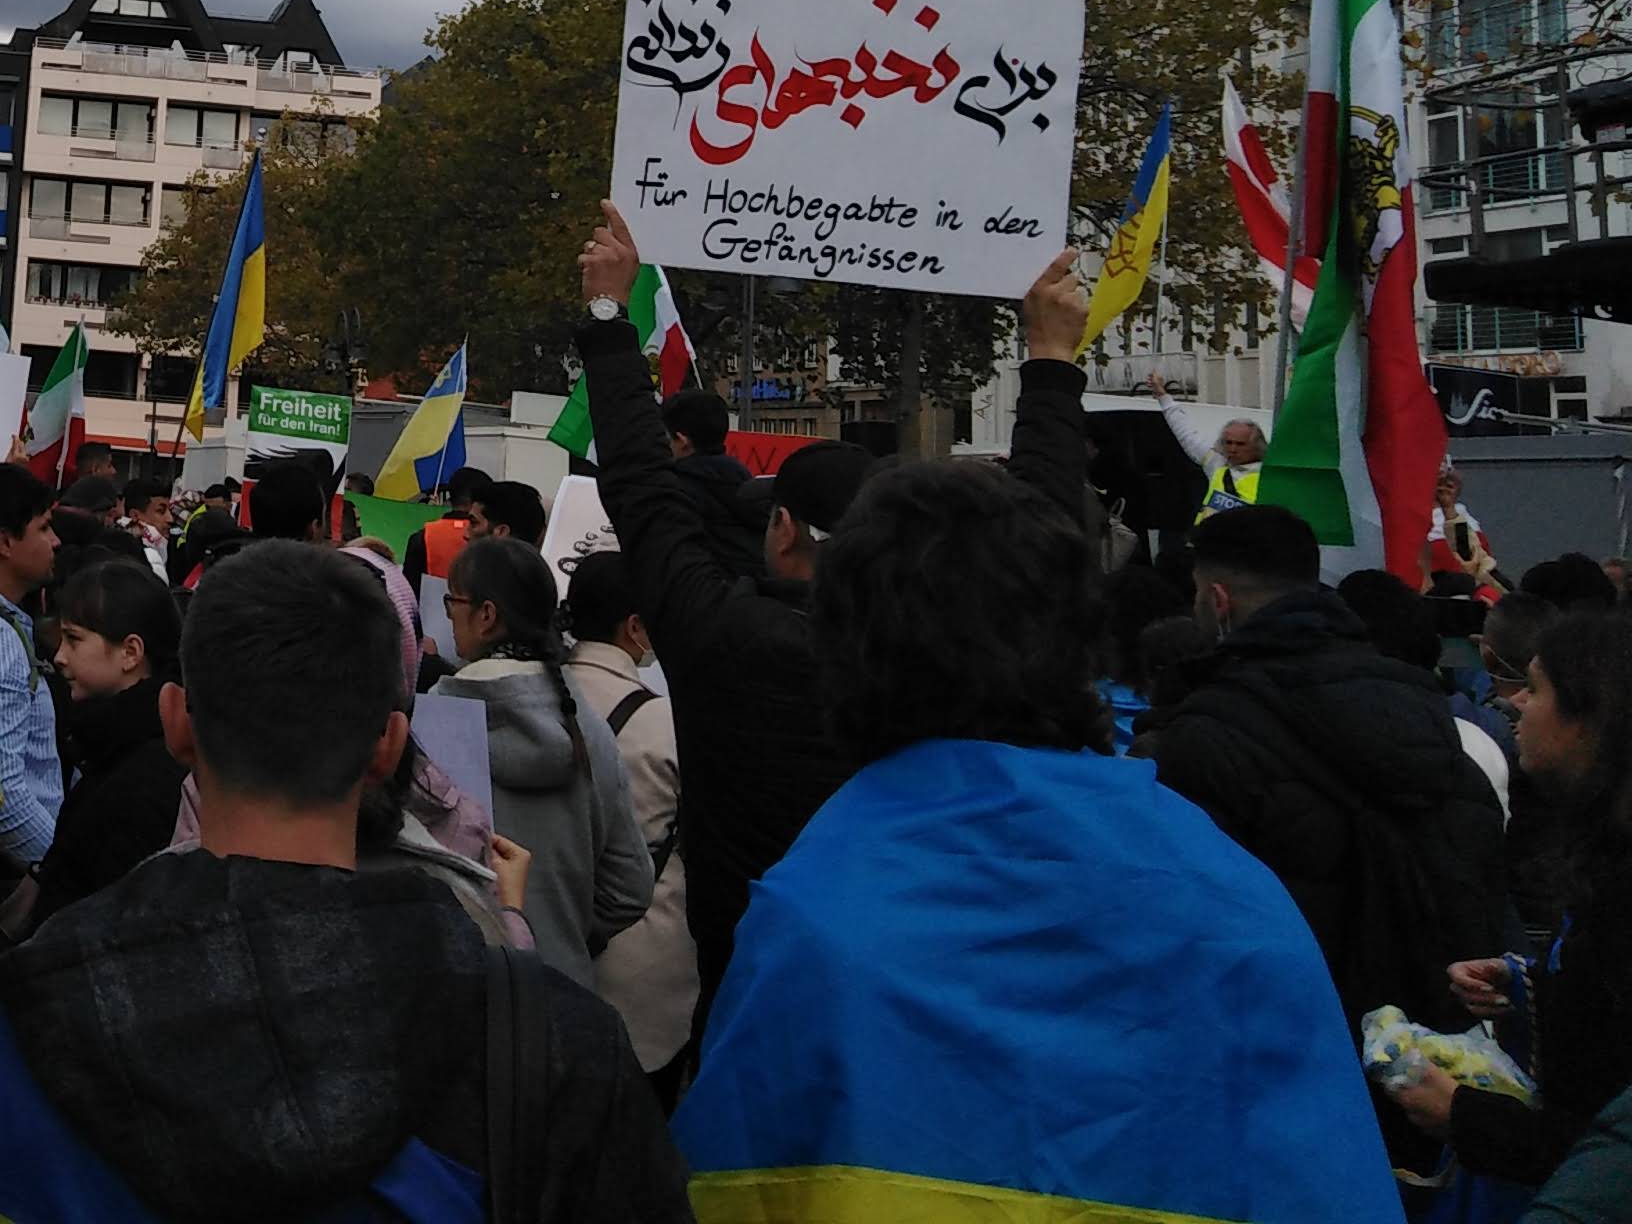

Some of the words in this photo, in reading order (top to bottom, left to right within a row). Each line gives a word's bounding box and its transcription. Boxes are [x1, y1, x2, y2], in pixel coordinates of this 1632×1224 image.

[704, 178, 921, 241] Hochbegabte
[935, 200, 964, 231] in
[983, 206, 1045, 238] den
[701, 219, 945, 277] Gefängnissen
[257, 413, 278, 427] für
[280, 417, 306, 431] den
[309, 419, 341, 436] Iran!
[259, 392, 342, 421] Freiheit
